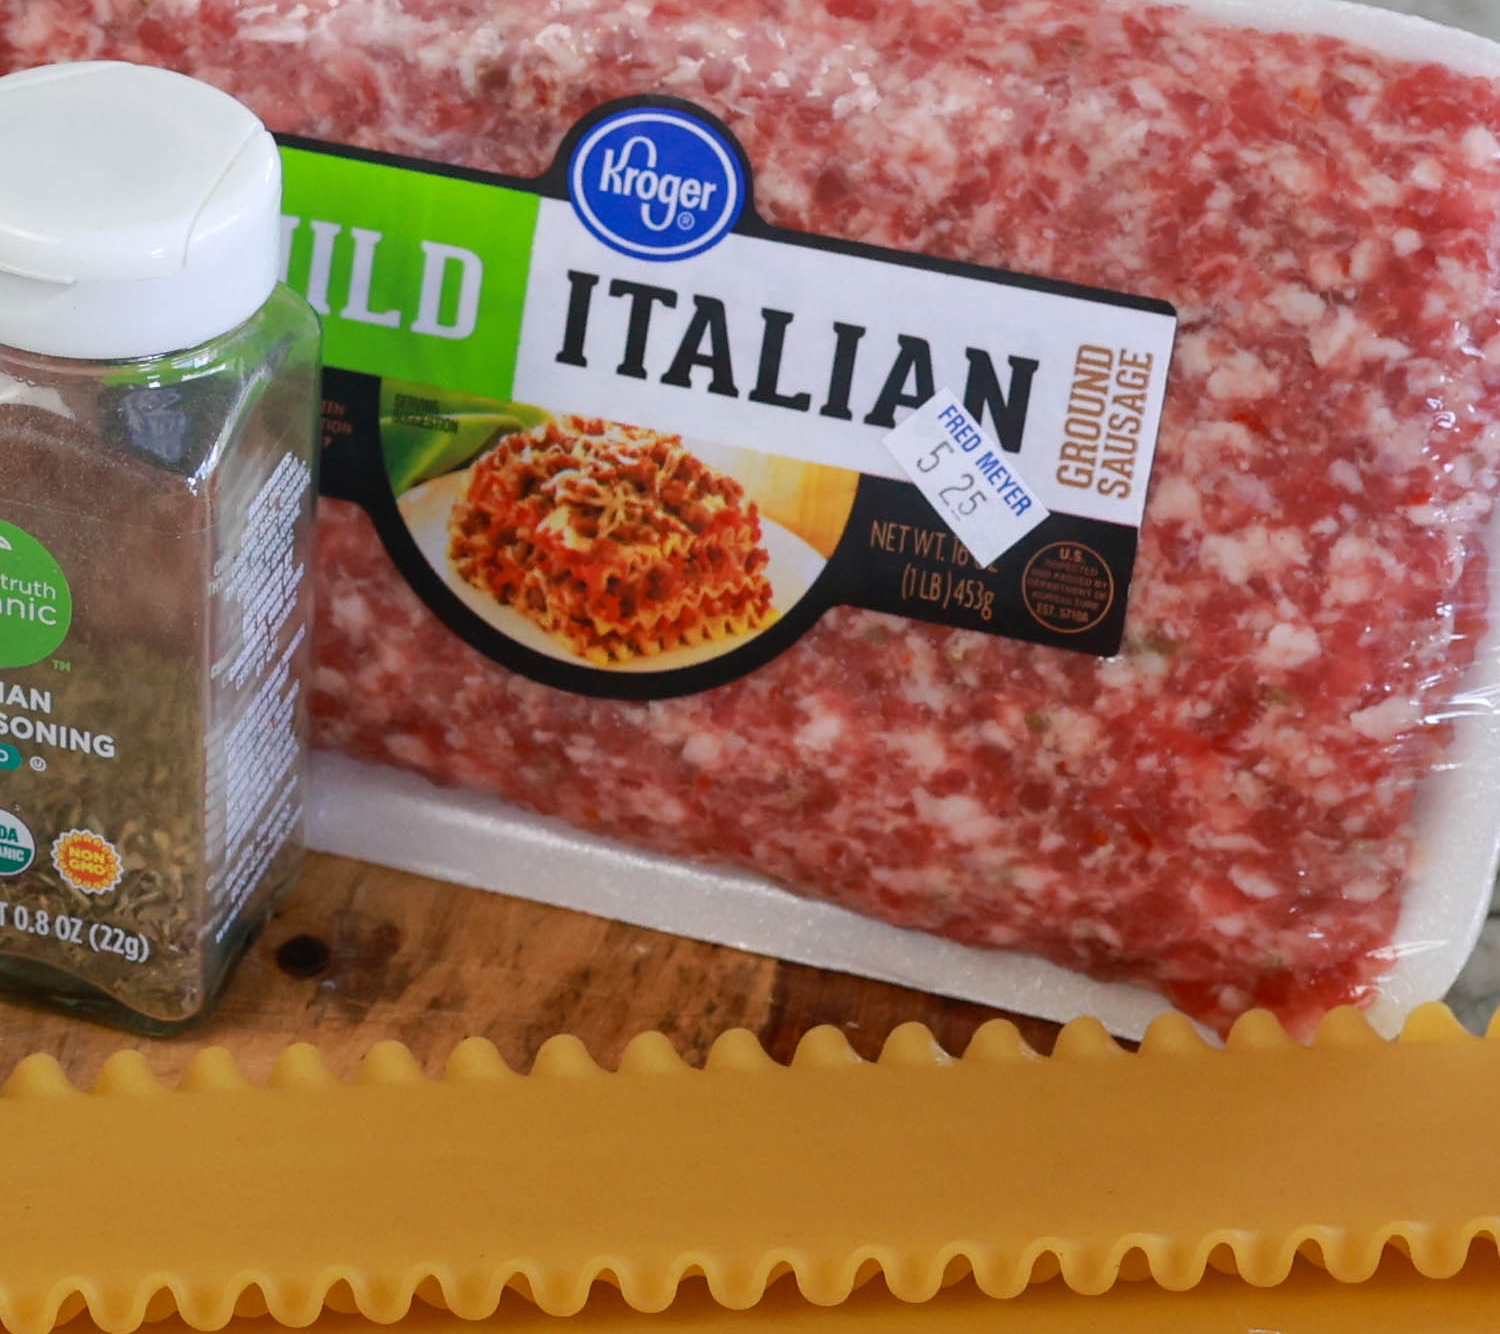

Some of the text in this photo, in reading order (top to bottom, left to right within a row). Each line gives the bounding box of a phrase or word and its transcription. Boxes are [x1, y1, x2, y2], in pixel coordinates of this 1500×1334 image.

[598, 135, 718, 232] Kroger
[281, 213, 1040, 454] ILD ITALIAN
[1055, 343, 1115, 490] GROUND
[1096, 348, 1154, 500] SAUSAGE
[936, 403, 984, 455] FRED
[974, 450, 1034, 518] MEYER
[869, 519, 909, 554] NET
[912, 528, 947, 563] WT.
[0, 571, 57, 602] truth
[953, 577, 996, 622] 453g
[68, 846, 106, 864] NON
[68, 858, 107, 876] GMO
[13, 905, 50, 937] 0.8
[54, 914, 84, 945] OZ
[88, 922, 150, 964] (22g)
